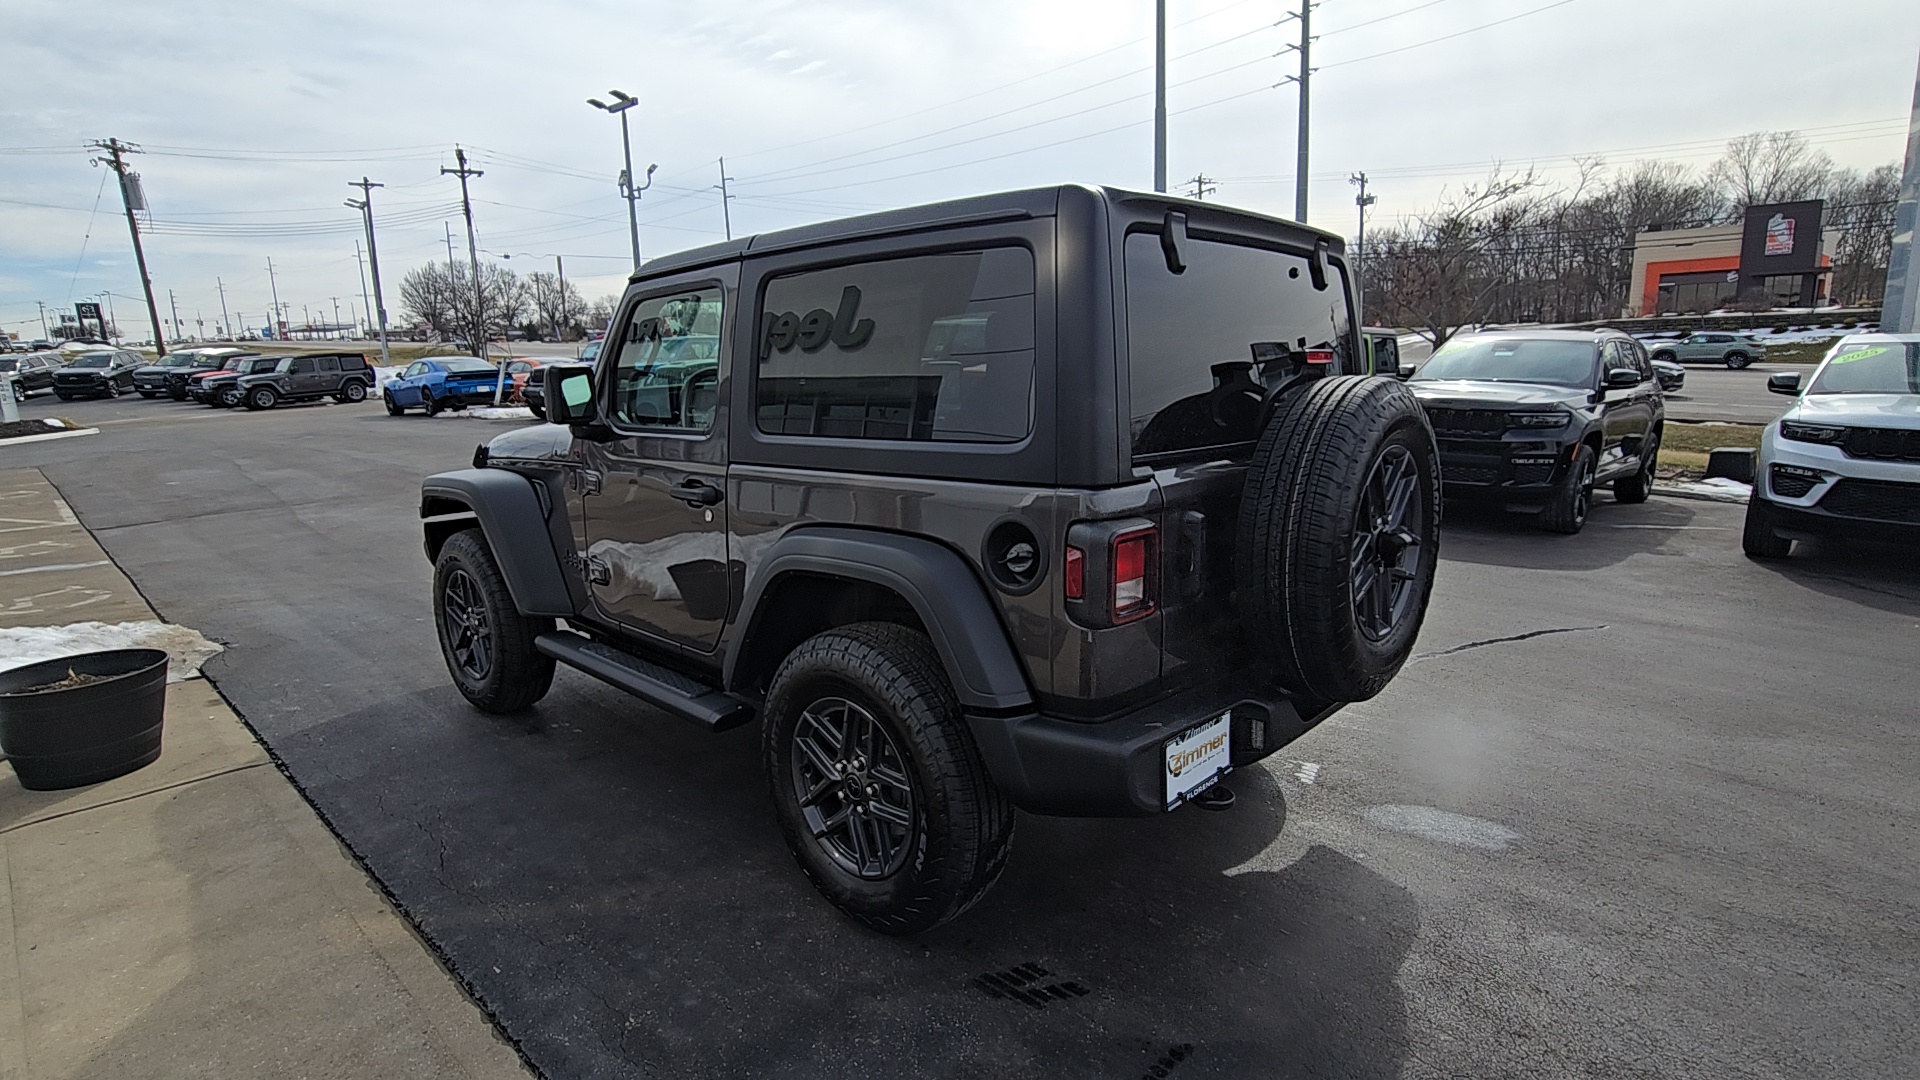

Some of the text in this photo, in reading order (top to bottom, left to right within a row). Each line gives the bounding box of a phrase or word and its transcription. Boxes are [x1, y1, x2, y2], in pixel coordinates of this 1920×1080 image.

[1842, 350, 1878, 362] 2025
[1183, 717, 1218, 742] Zimmer
[1169, 732, 1228, 776] Zimmer
[1186, 775, 1219, 801] FLORENCE
